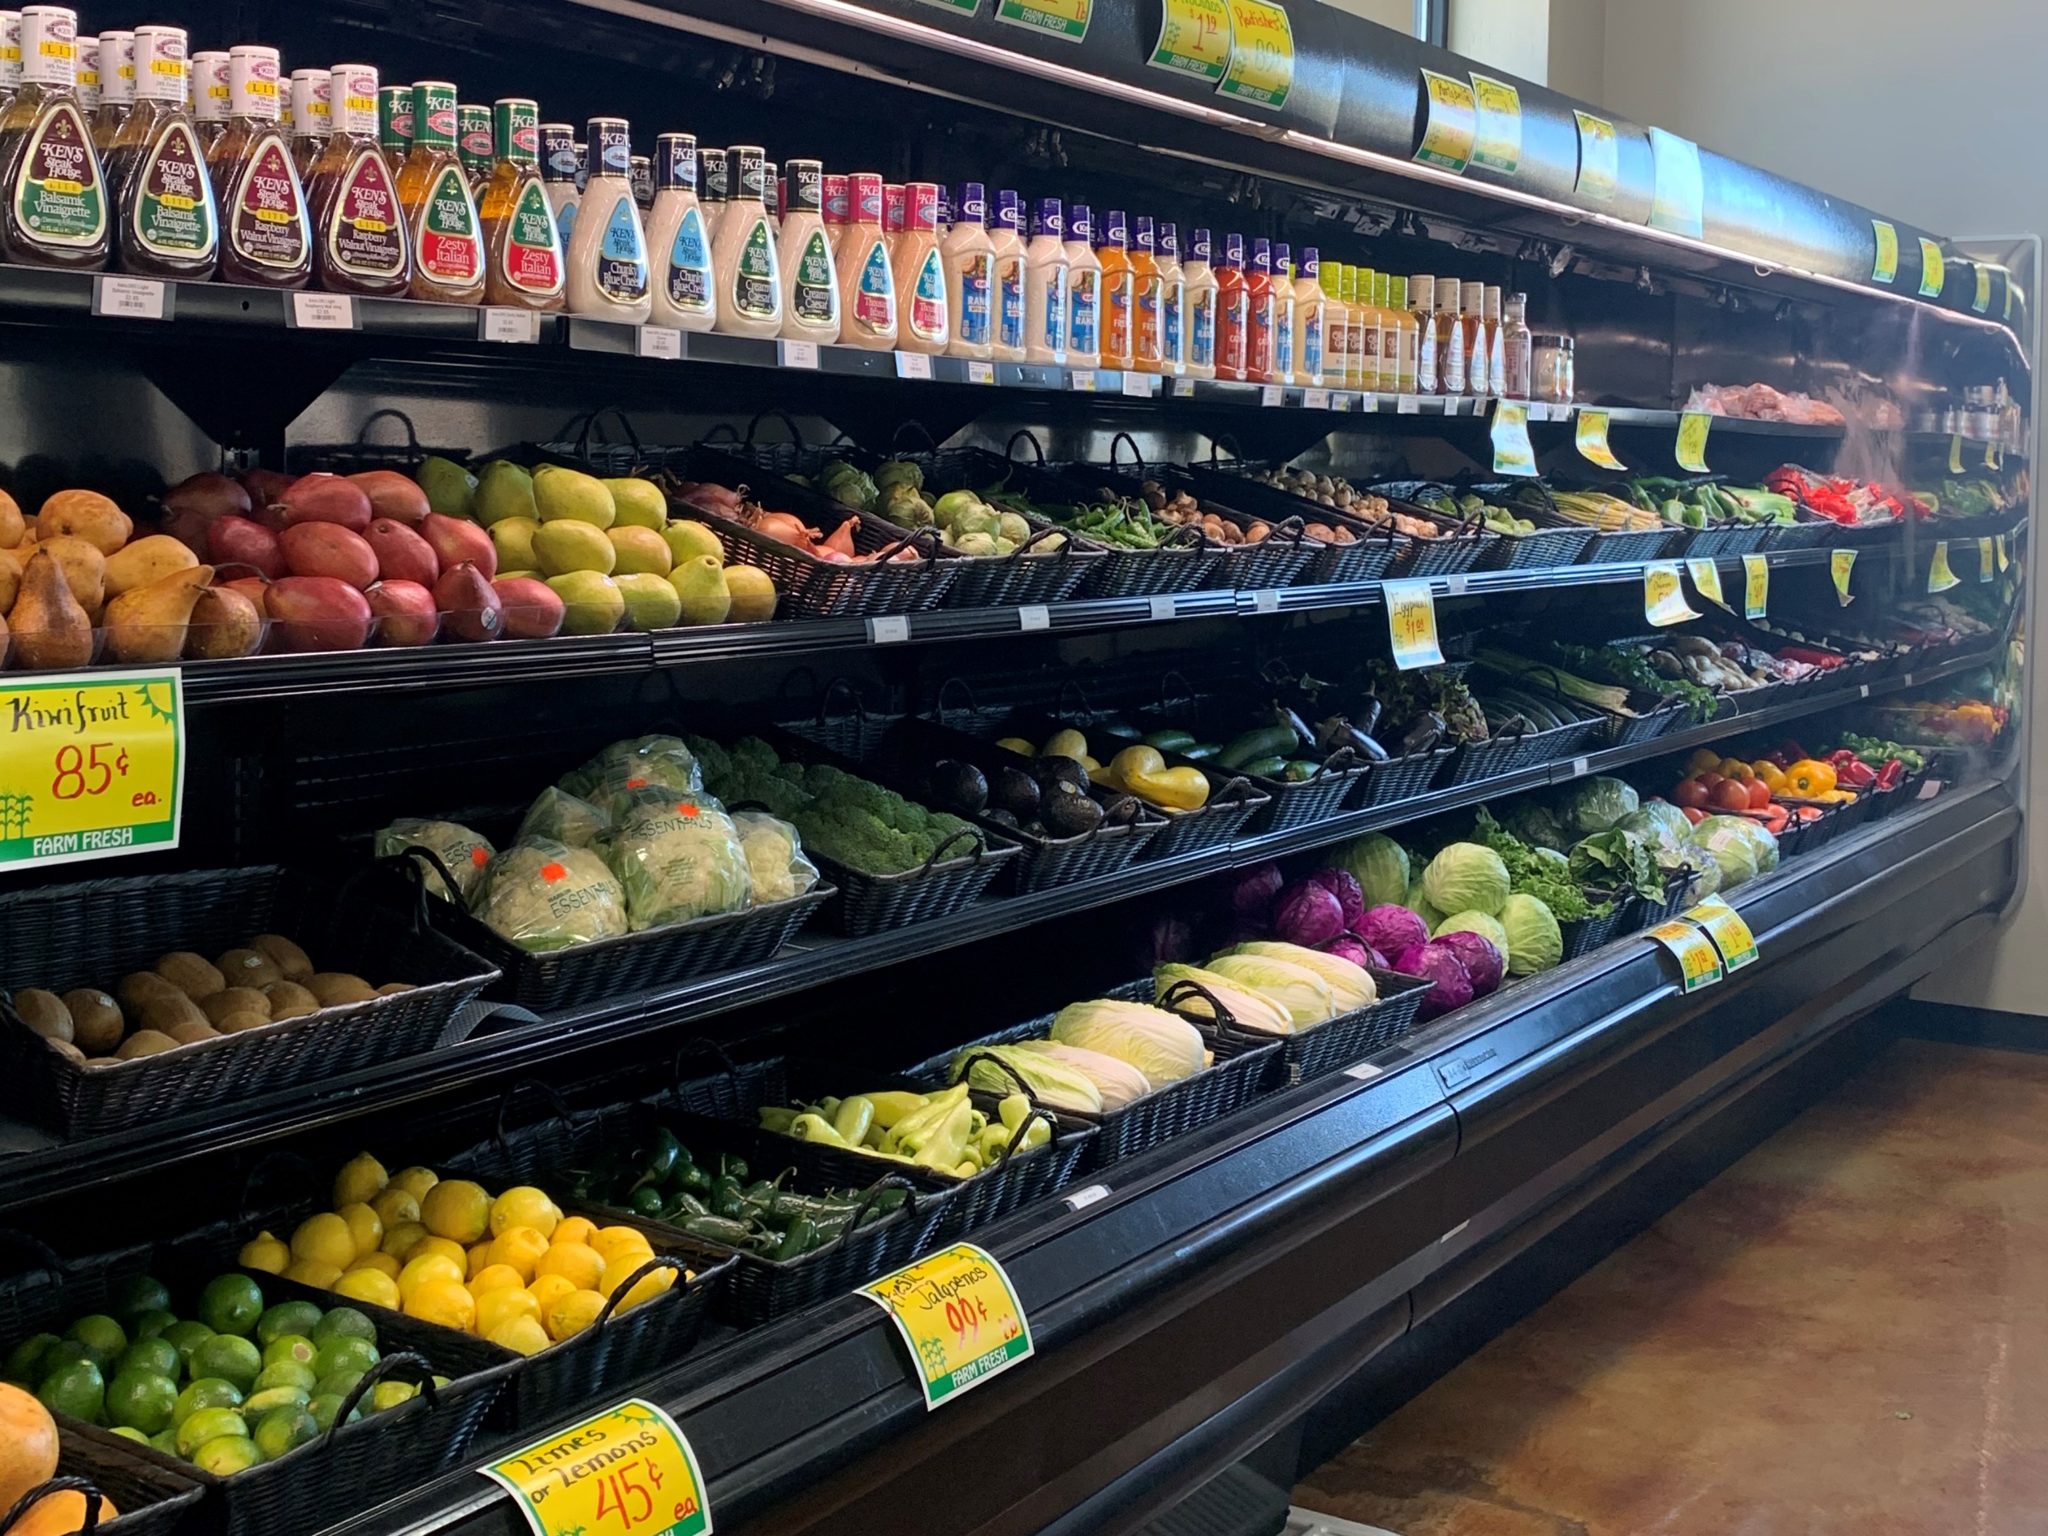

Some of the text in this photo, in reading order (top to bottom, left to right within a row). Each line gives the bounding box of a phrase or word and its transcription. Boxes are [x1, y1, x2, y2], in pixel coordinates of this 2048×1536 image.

[1021, 8, 1068, 31] FARM FRESH
[1169, 54, 1209, 73] FARM FRESH
[1236, 83, 1272, 101] FARM FRESH
[40, 143, 84, 163] KEN'S
[44, 156, 73, 170] Steak
[157, 159, 196, 180] KEN'S
[48, 167, 83, 180] House
[160, 173, 186, 185] Steak
[164, 183, 194, 196] House
[253, 176, 290, 195] KEN'S
[39, 190, 86, 207] Balsamic
[351, 186, 388, 205] KEN'S
[33, 200, 91, 217] Vinaigrette
[156, 205, 197, 222] Balsamic
[434, 199, 466, 216] KEN'S
[151, 214, 201, 232] Vinaigrette
[254, 220, 290, 237] Raspberry
[520, 212, 549, 229] KEN'S
[240, 229, 268, 243] Walnut
[437, 236, 468, 256] Zesty
[436, 248, 470, 265] Italian
[522, 248, 550, 265] Zesty
[521, 259, 552, 276] Italian
[603, 271, 621, 286] Blue
[6, 690, 130, 735] Kiwifruit
[52, 742, 130, 800] 85¢
[132, 790, 163, 808] ea.
[33, 827, 133, 857] FARM FRESH
[911, 1266, 988, 1311] Jalapenos
[951, 1346, 1009, 1388] FARM FRESH
[511, 1428, 607, 1475] Limes
[531, 1431, 658, 1505] or Lemons
[596, 1456, 663, 1530] 45¢
[674, 1497, 698, 1521] ea
